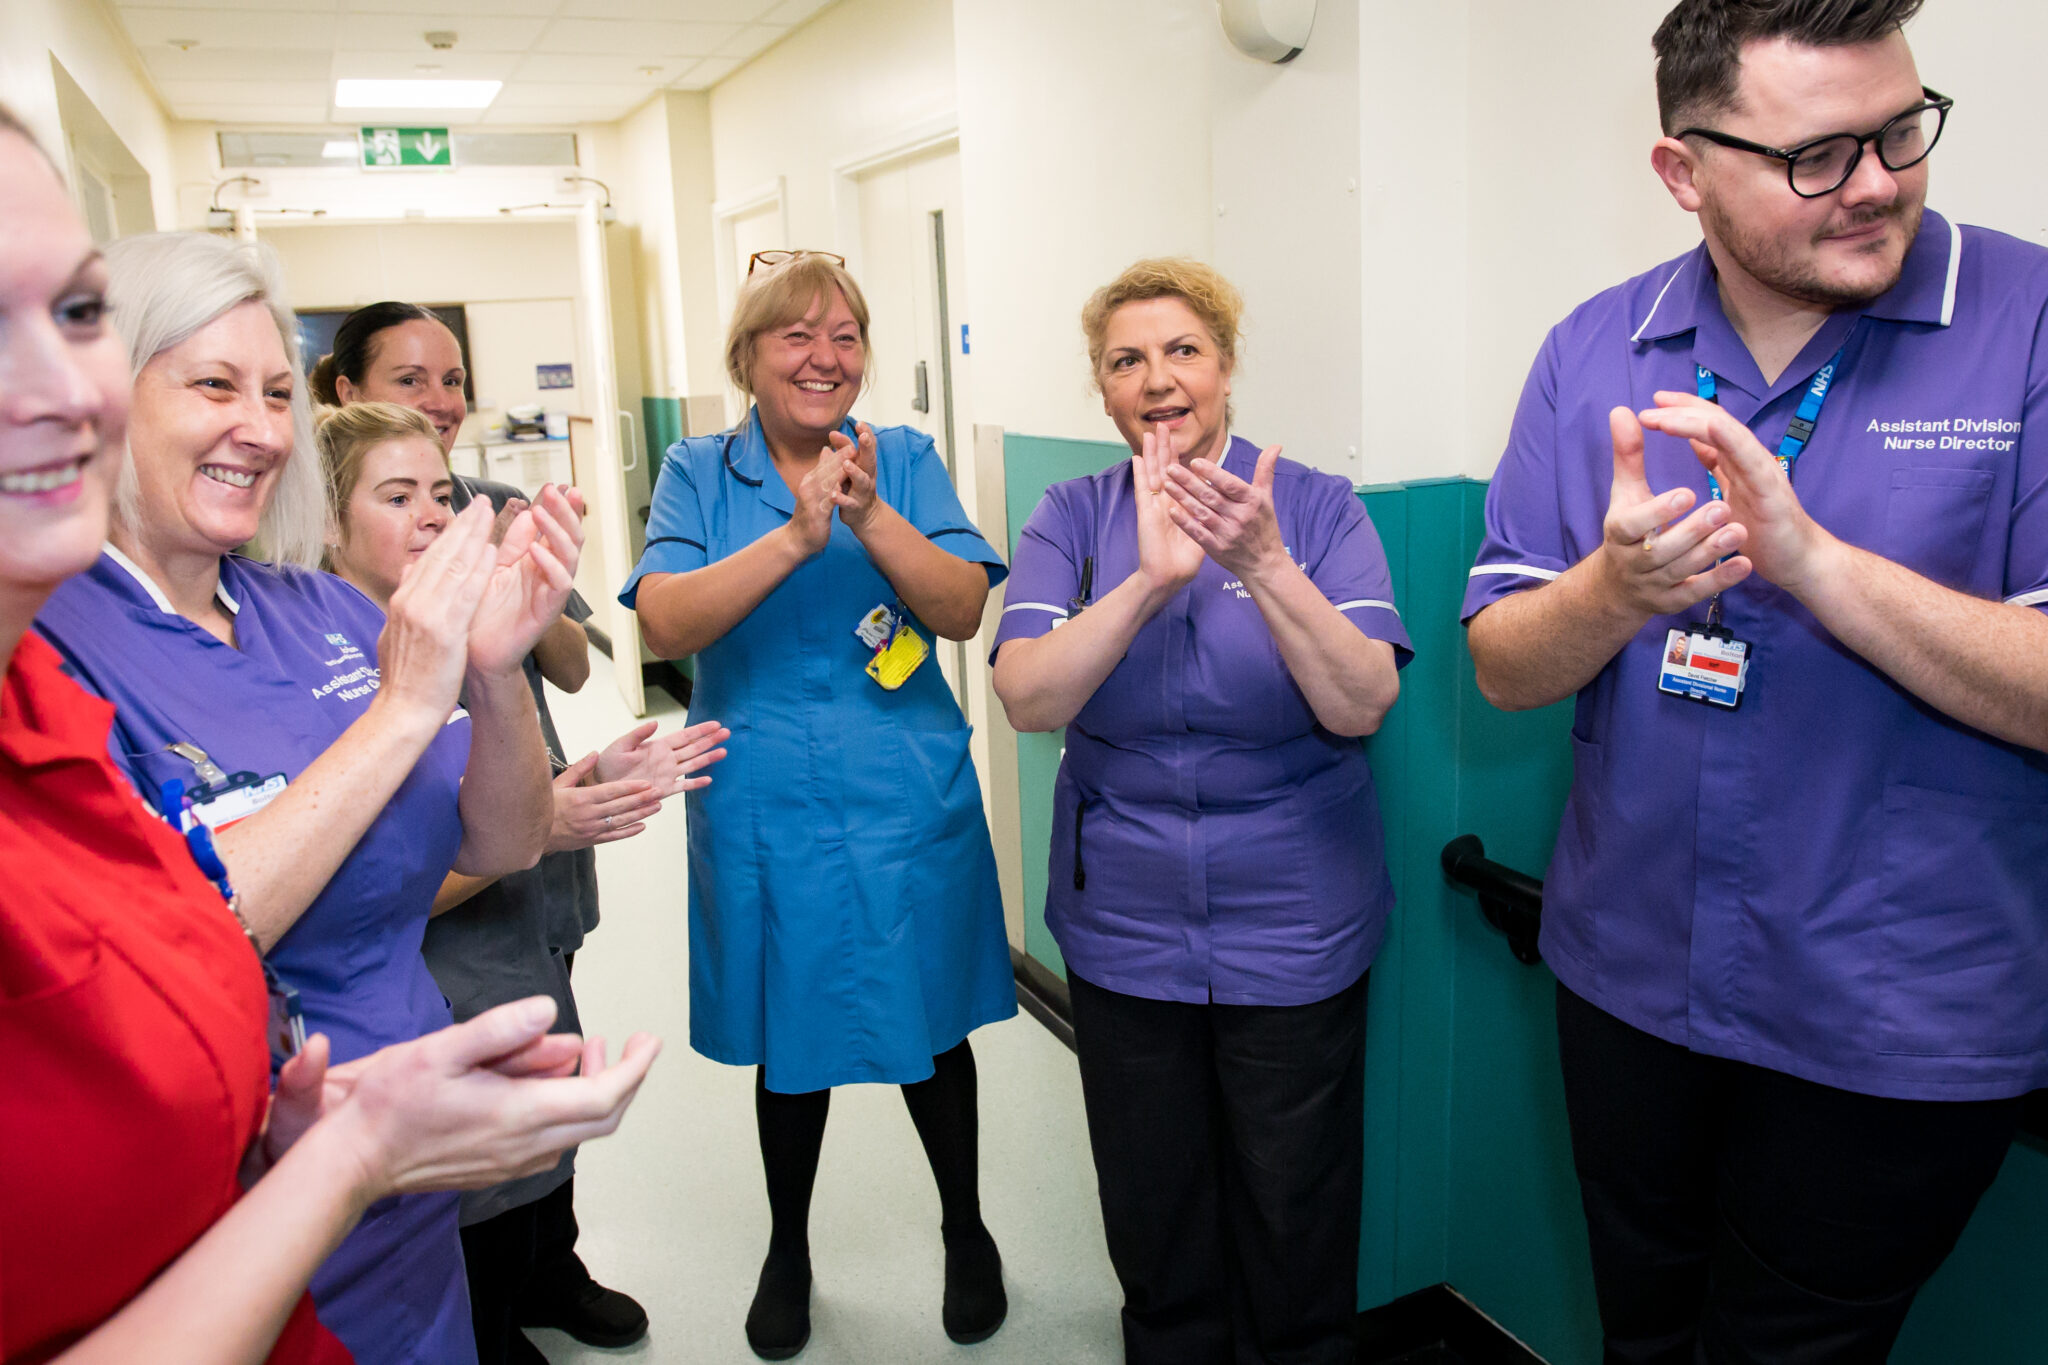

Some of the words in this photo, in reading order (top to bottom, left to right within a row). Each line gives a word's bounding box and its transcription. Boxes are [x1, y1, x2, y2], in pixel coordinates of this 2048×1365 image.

[1811, 364, 1834, 397] NHS
[1866, 418, 1950, 433] Assistant
[1883, 436, 1936, 450] Nurse
[1939, 436, 2015, 452] Director
[337, 684, 373, 702] Nurse
